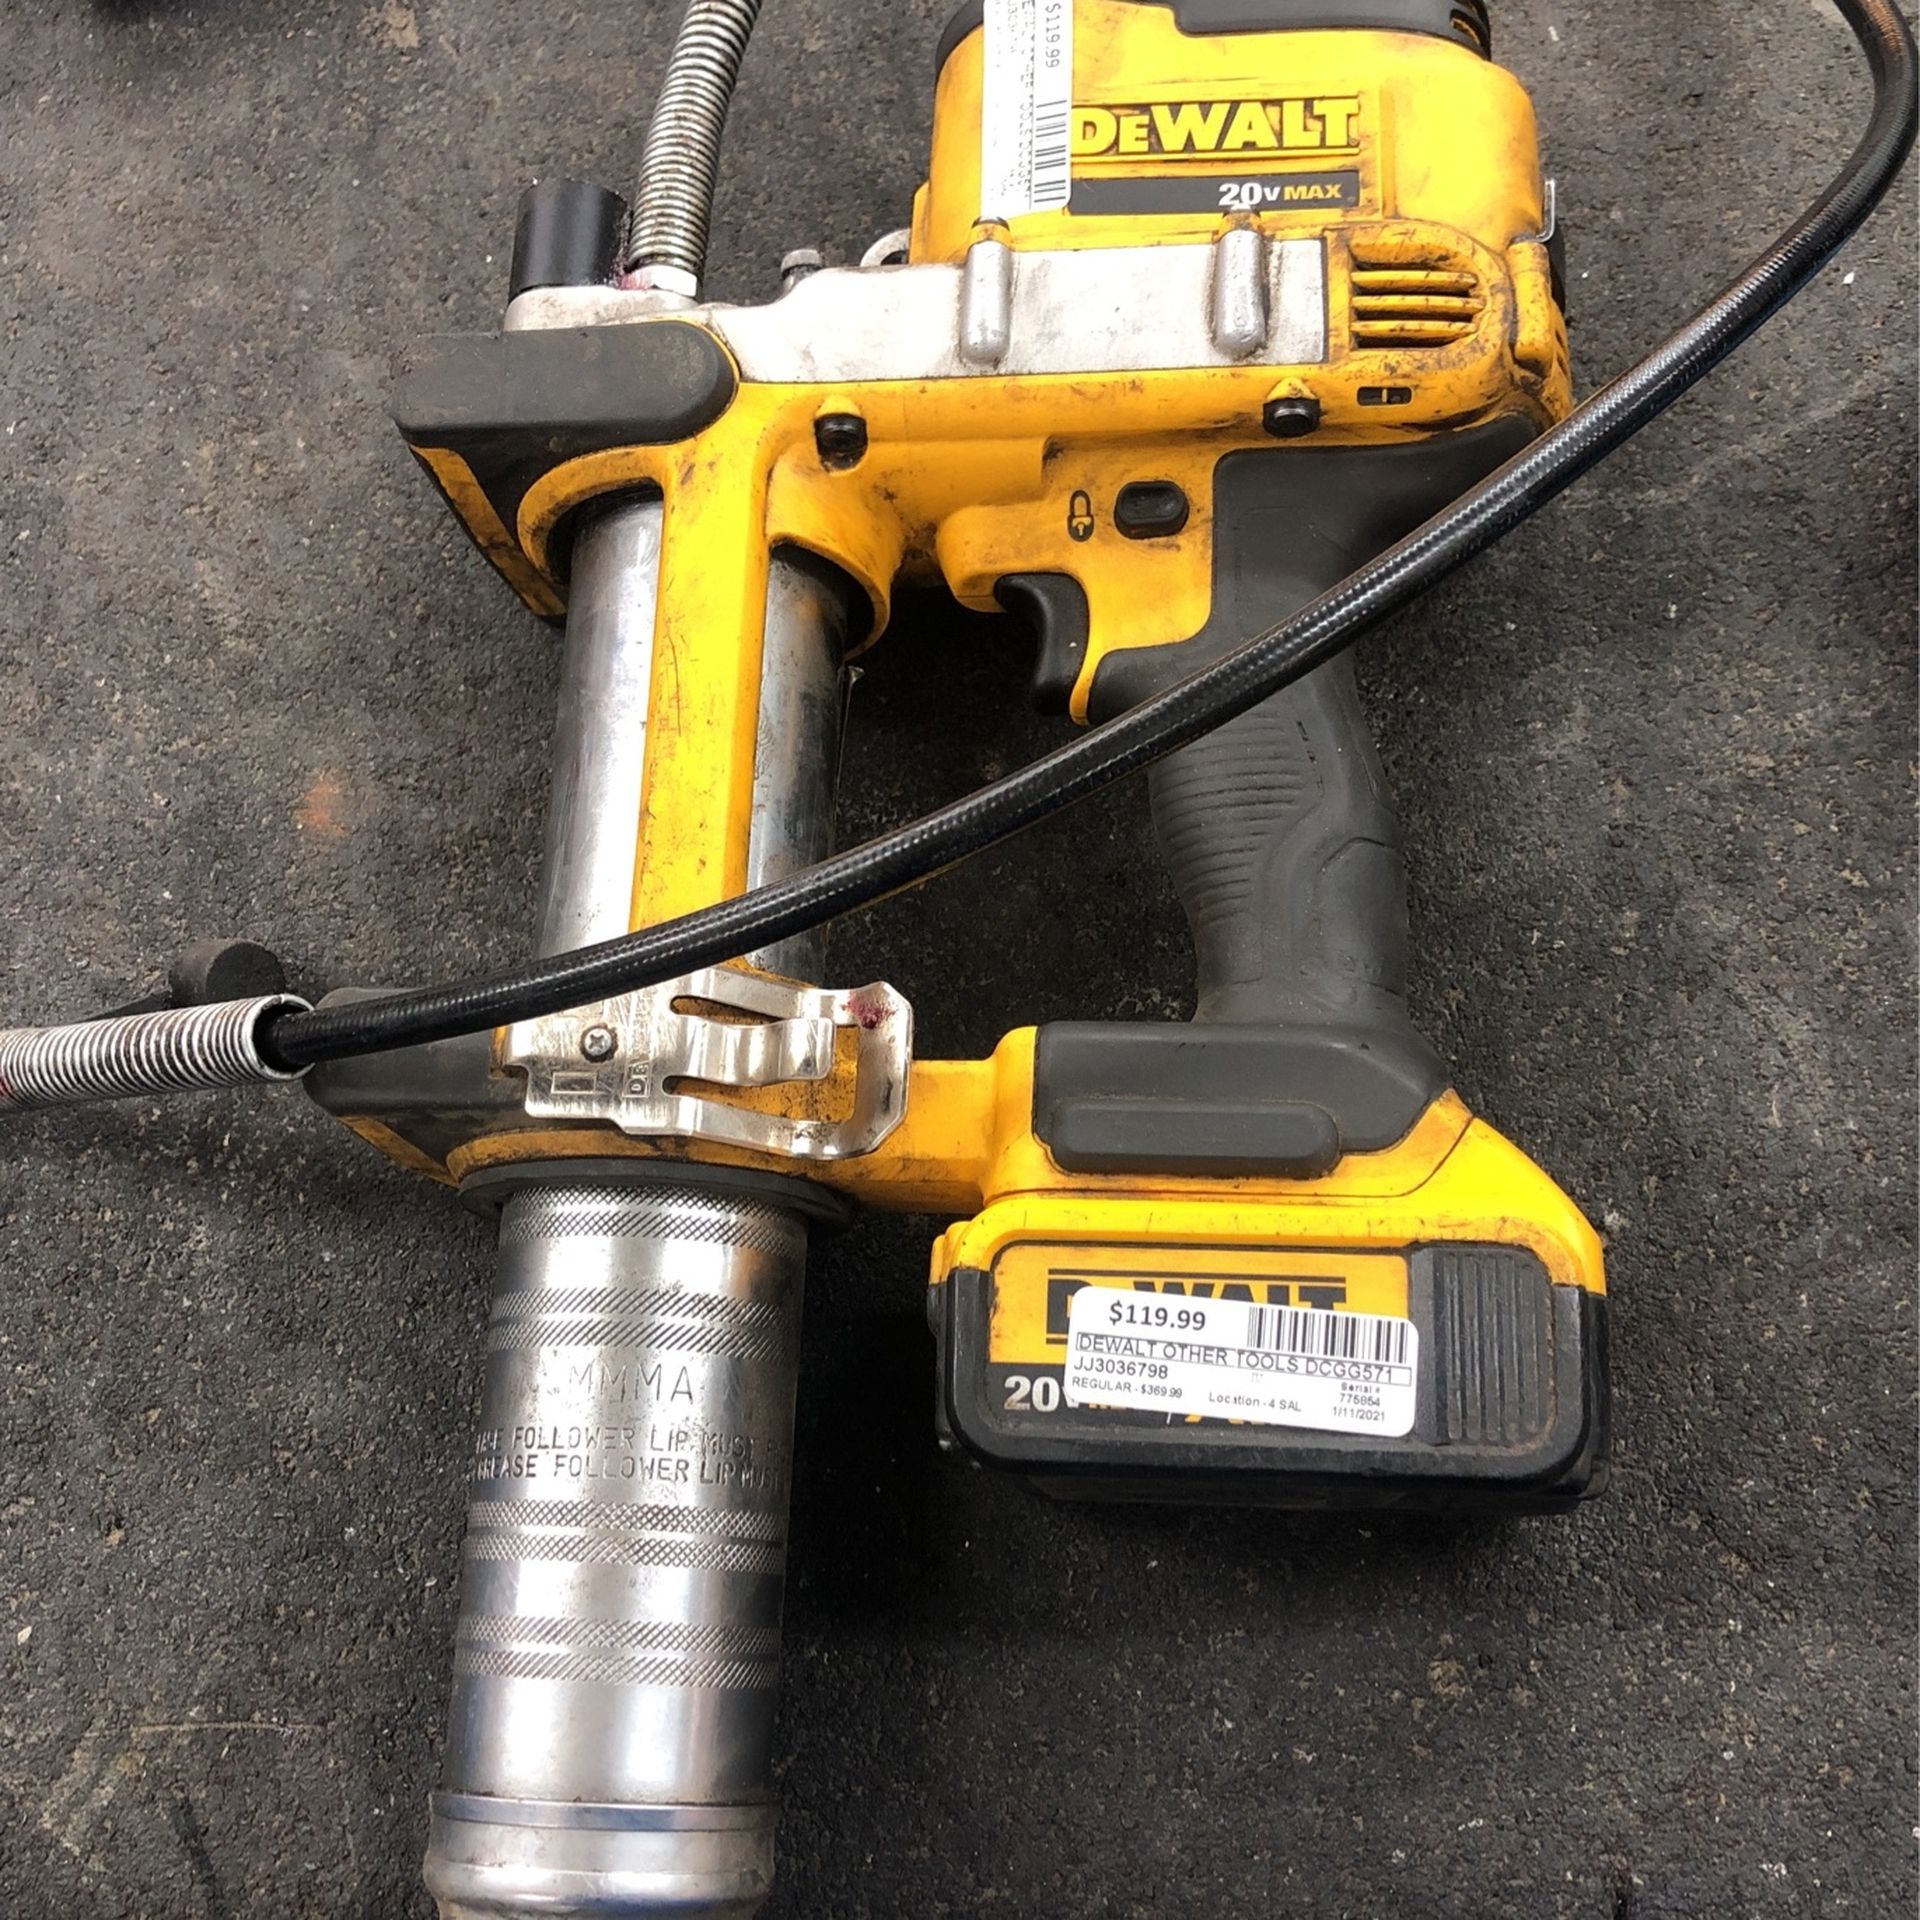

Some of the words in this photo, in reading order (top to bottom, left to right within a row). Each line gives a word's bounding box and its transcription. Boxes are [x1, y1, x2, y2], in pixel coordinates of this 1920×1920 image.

[1045, 2, 1062, 69] $119.99
[1071, 97, 1359, 157] DEWALT
[1284, 183, 1342, 201] MAX
[1109, 1299, 1207, 1331] $119.99
[1073, 1356, 1169, 1380] JJ3036798
[1079, 1333, 1158, 1358] DEWALT
[1163, 1342, 1229, 1366] OTHER
[1237, 1349, 1299, 1374] TOOLS
[1305, 1358, 1392, 1383] DCGG571
[1072, 1376, 1132, 1393] REGULAR
[1341, 1381, 1372, 1394] Serial
[512, 1426, 636, 1450] FOLLOWER
[650, 1424, 689, 1452] LIP
[554, 1454, 690, 1484] FOLLOWER
[700, 1460, 737, 1487] LIP
